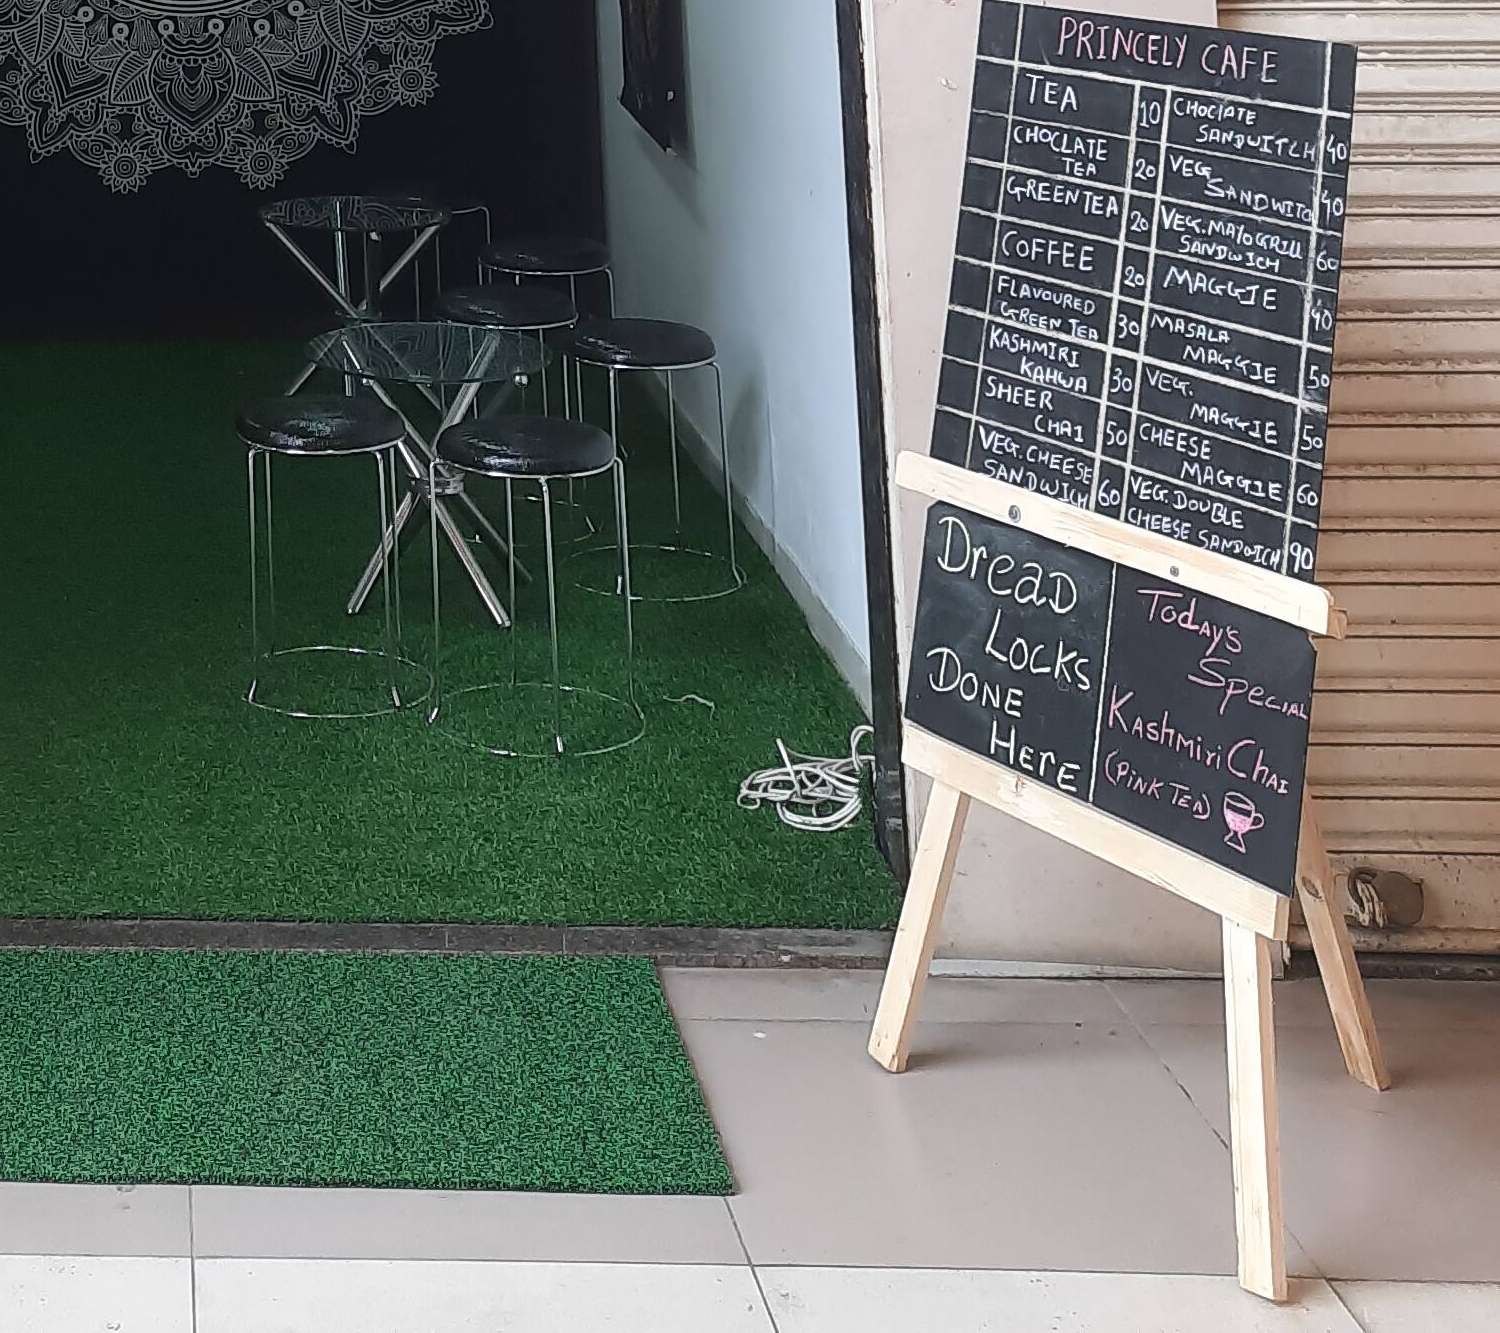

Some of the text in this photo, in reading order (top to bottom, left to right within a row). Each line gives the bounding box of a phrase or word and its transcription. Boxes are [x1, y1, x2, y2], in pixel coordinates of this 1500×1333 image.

[1056, 15, 1279, 84] PRINCELY CAFE
[1025, 72, 1162, 129] TEA 10
[1012, 124, 1109, 161] CHOCLATE
[1325, 133, 1348, 165] 40
[1060, 156, 1157, 181] TEA 20
[1168, 153, 1213, 180] VEG
[1129, 209, 1150, 233] 20
[1321, 189, 1344, 228] 40
[1001, 230, 1145, 288] COFFEE 20
[1315, 250, 1339, 271] 60
[997, 275, 1096, 316] FLAVOURED
[1163, 265, 1333, 331] MAGGIE 40
[1000, 301, 1140, 341] GREEN TEA 30
[1150, 313, 1231, 344] MASALA
[989, 324, 1081, 369] KASHMIRI
[1182, 344, 1330, 389] MAGGIE 50
[984, 375, 1054, 411] SHEER
[1020, 355, 1133, 393] KAHWA 30
[1106, 420, 1128, 447] 50
[1139, 422, 1212, 460] CHEESE
[1189, 402, 1323, 451] MAGGIE 50
[1098, 479, 1121, 507] 60
[1180, 460, 1319, 507] MAGGIE 60
[1171, 489, 1245, 530] DOUBLE
[1127, 507, 1192, 540] CHEESE
[1289, 541, 1314, 574] 90
[984, 607, 1091, 691] LOCKS
[926, 646, 1024, 718] DONE
